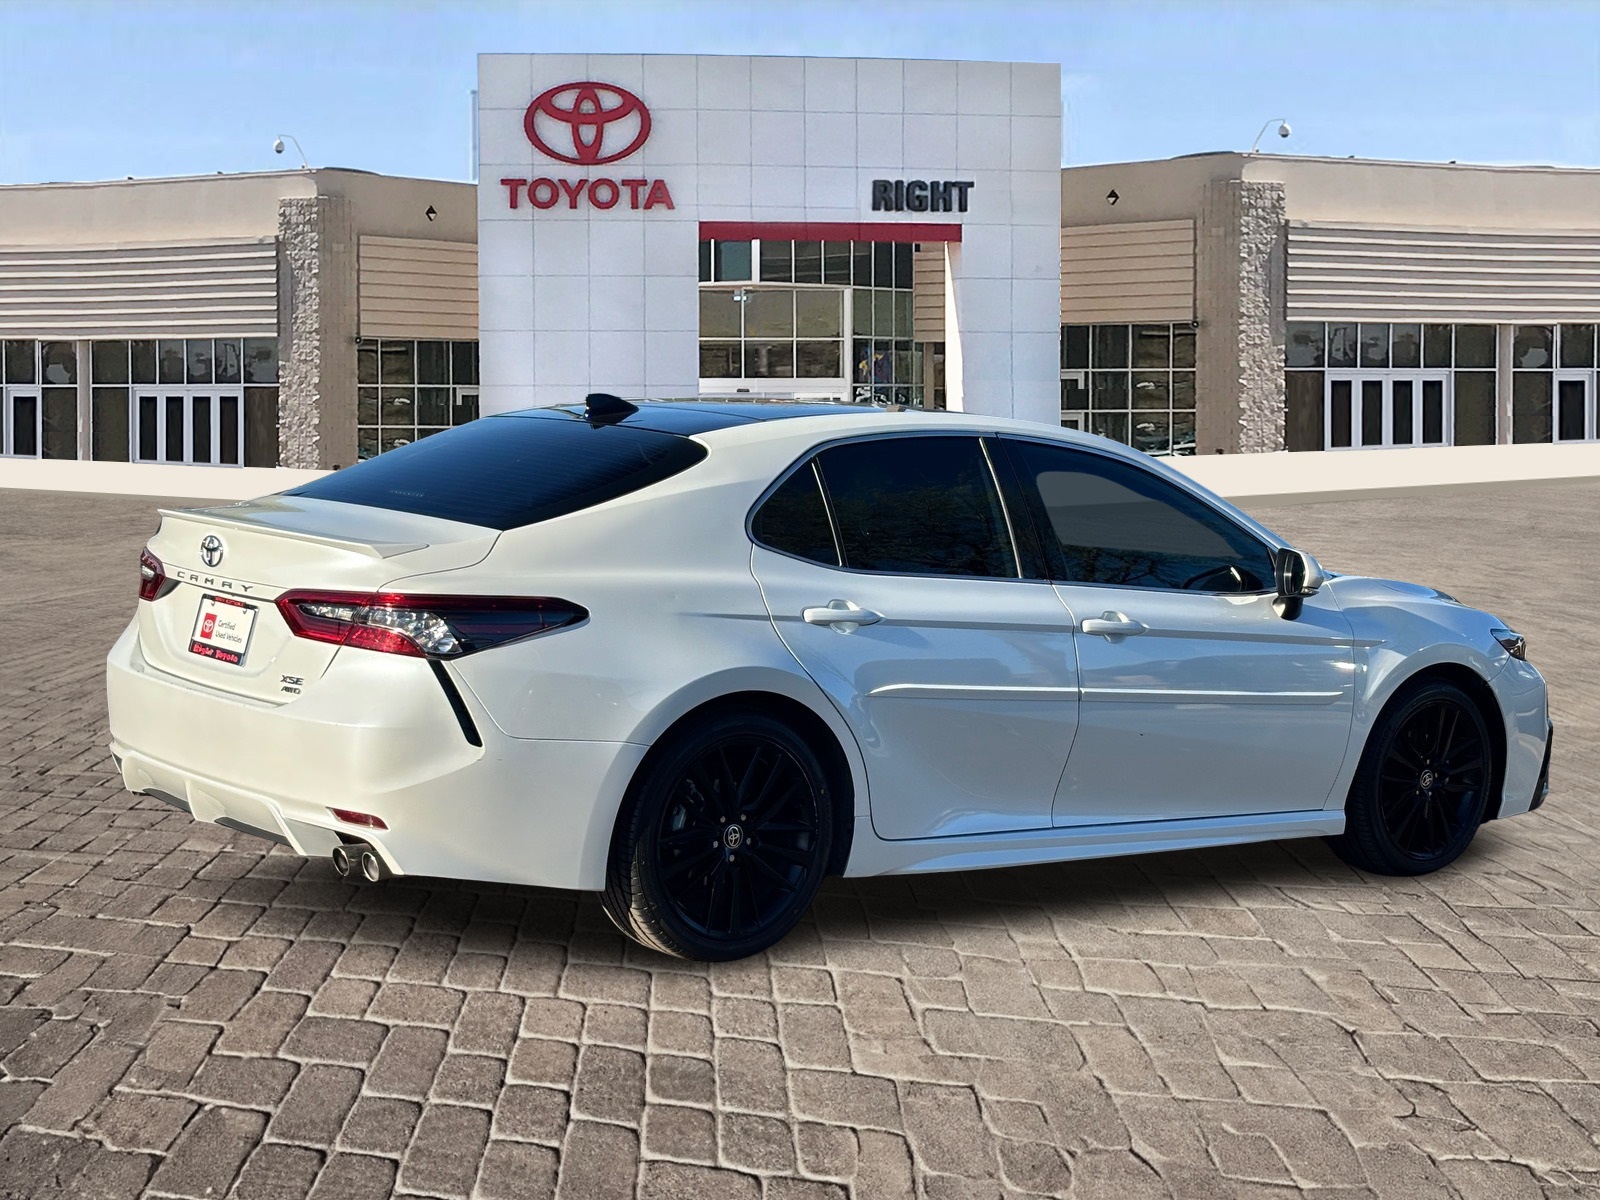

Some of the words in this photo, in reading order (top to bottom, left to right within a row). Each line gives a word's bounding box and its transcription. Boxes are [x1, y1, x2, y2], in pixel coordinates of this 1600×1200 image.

[500, 178, 675, 209] TOYOTA
[872, 179, 974, 212] RIGHT
[177, 571, 253, 592] CAMRY
[218, 620, 236, 630] Certified
[215, 630, 226, 640] Used
[226, 632, 242, 643] Vehicles
[215, 649, 238, 663] Toyota
[280, 675, 304, 686] XSE
[280, 685, 302, 695] AWD
